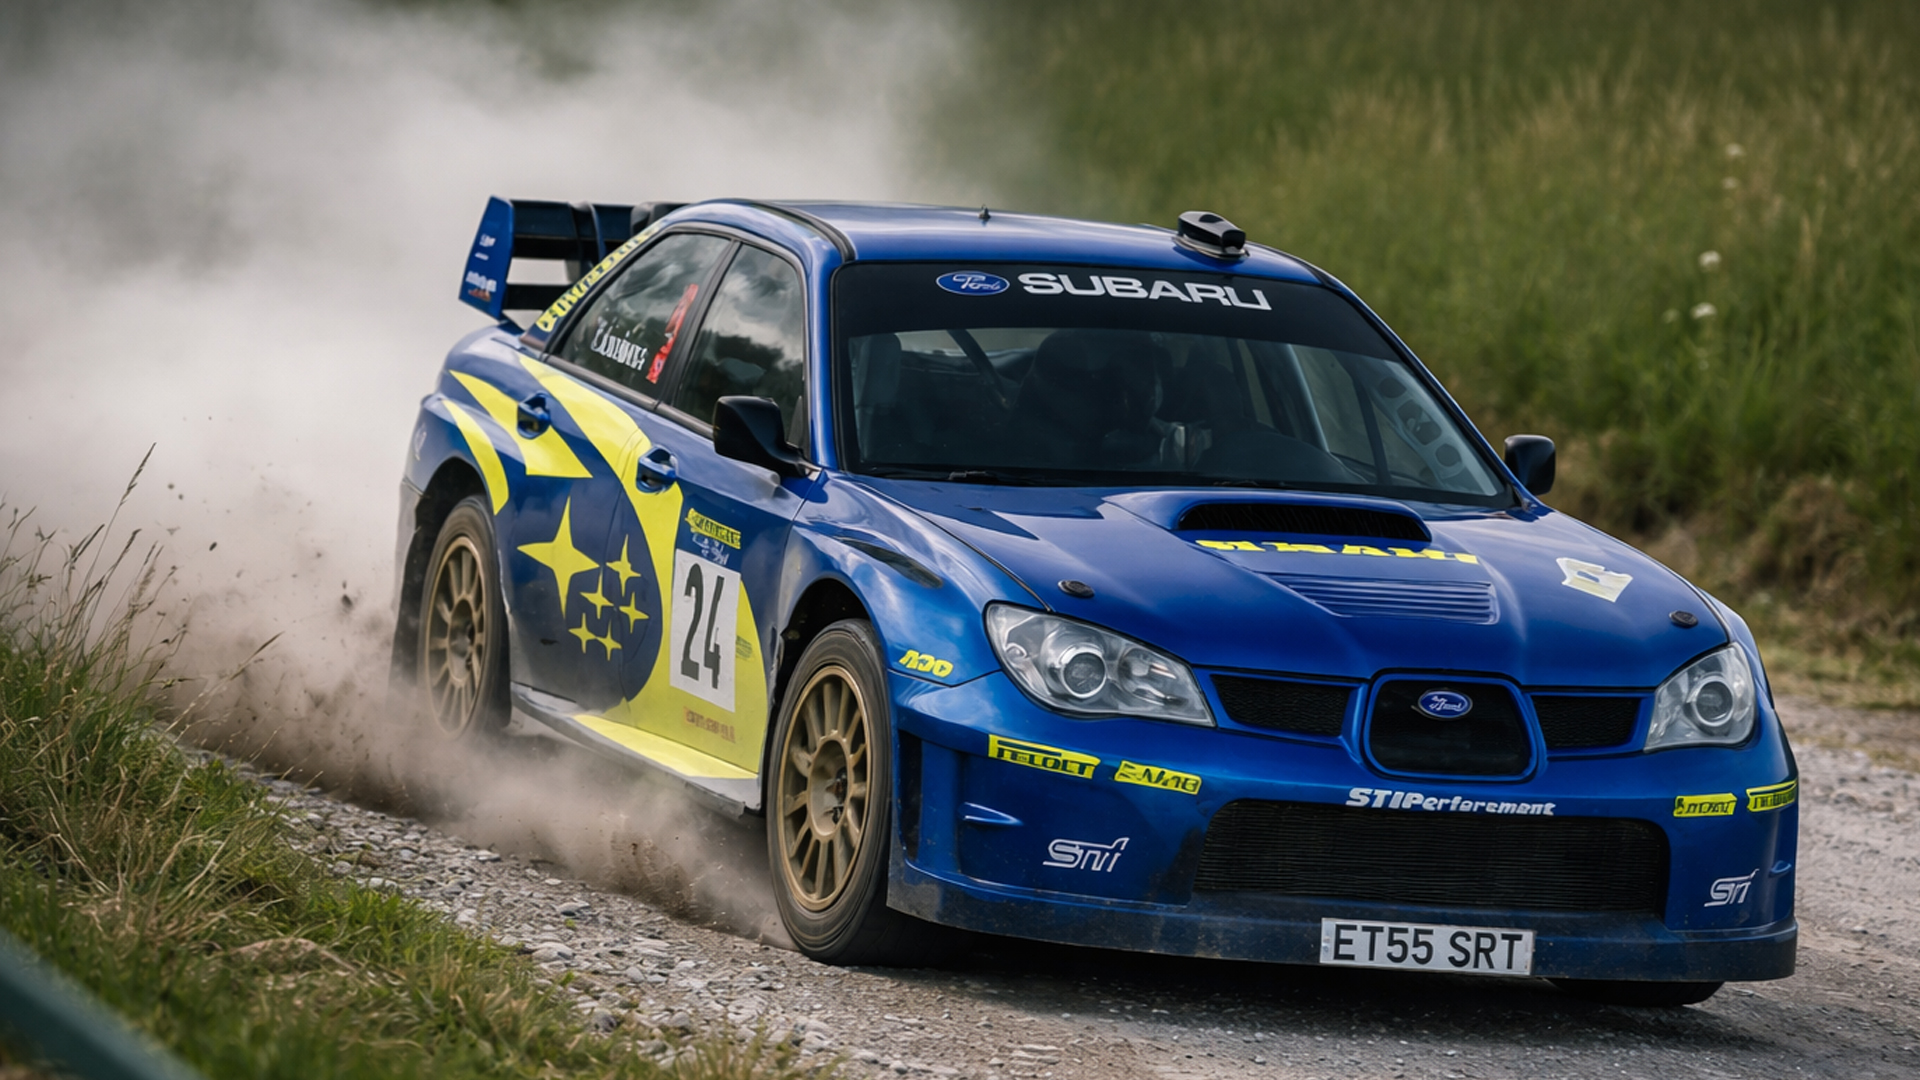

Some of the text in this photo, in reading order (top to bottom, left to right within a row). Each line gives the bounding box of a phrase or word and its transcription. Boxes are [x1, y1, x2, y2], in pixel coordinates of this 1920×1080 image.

[1018, 272, 1273, 311] SUBARU
[680, 563, 725, 690] 24
[1333, 923, 1523, 970] ET55 SRT
